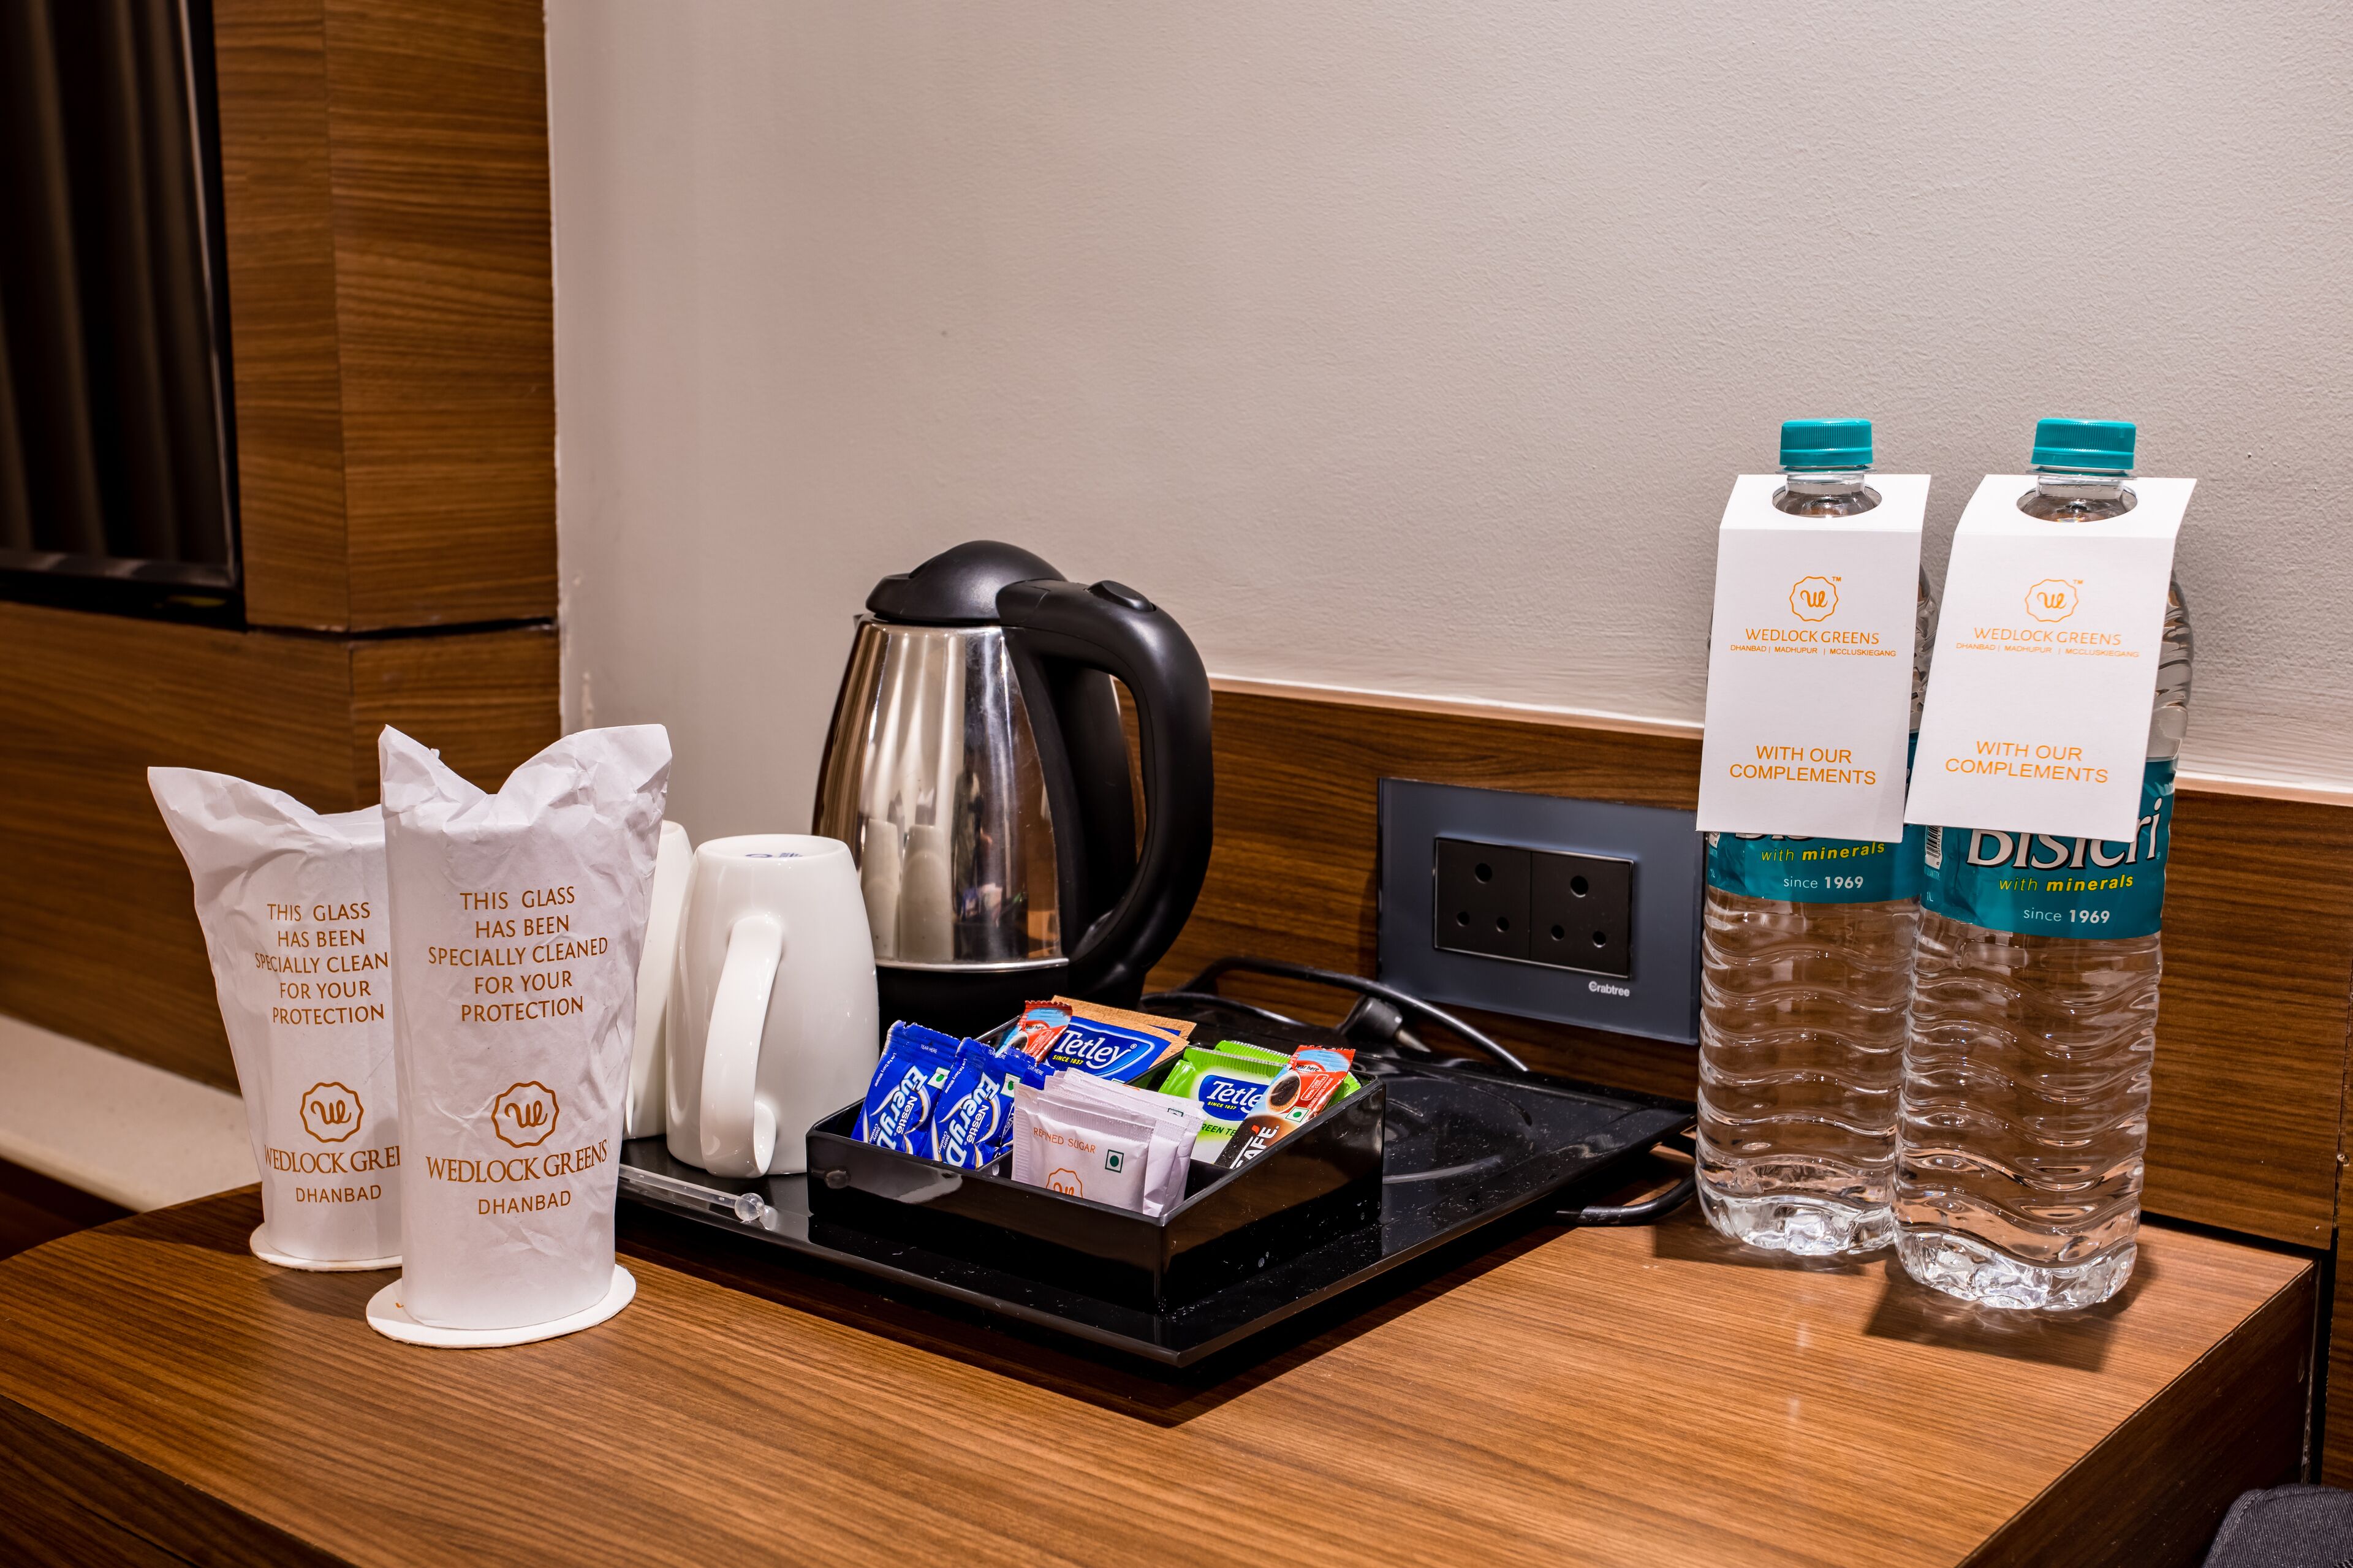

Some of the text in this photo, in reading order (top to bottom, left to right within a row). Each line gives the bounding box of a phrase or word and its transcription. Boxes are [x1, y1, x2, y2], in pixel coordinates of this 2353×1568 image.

[1746, 629, 1879, 645] WEDLOCK GREENS
[1974, 627, 2120, 646] WEDLOCK GREENS
[2065, 648, 2139, 657] MCCLUSKIEGANG
[1756, 745, 1852, 763] WITH OUR
[1977, 741, 2082, 762] WITH OUR
[1730, 764, 1876, 784] COMPLEMENTS
[1946, 758, 2108, 783] COMPLEMENTS
[1762, 842, 1885, 861] with minerals
[1783, 876, 1863, 889] since 1969
[1999, 874, 2134, 892] with minerals
[461, 886, 575, 910] THIS GLASS
[268, 902, 371, 922] THIS GLASS
[2023, 907, 2110, 924] since 1969
[476, 915, 569, 938] HAS BEEN
[278, 930, 365, 947] HAS BEEN
[429, 937, 608, 967] SPECIALLY CLEANED
[256, 953, 320, 974] SPECIALLY
[281, 980, 371, 999] FOR YOUR
[475, 971, 572, 994] FOR YOUR
[1589, 981, 1630, 997] Crabtree
[274, 1004, 384, 1025] PROTECTION
[461, 998, 583, 1022] PROTECTION
[1055, 1030, 1131, 1069] Tetley
[1207, 1080, 1262, 1114] Tetle
[1033, 1127, 1096, 1153] REFINED SUGAR
[265, 1145, 347, 1174] WEDLOCK
[427, 1140, 607, 1183] WEDLOCK GREENS
[296, 1185, 382, 1203] DHANBAD
[478, 1190, 571, 1215] DHANBAD
